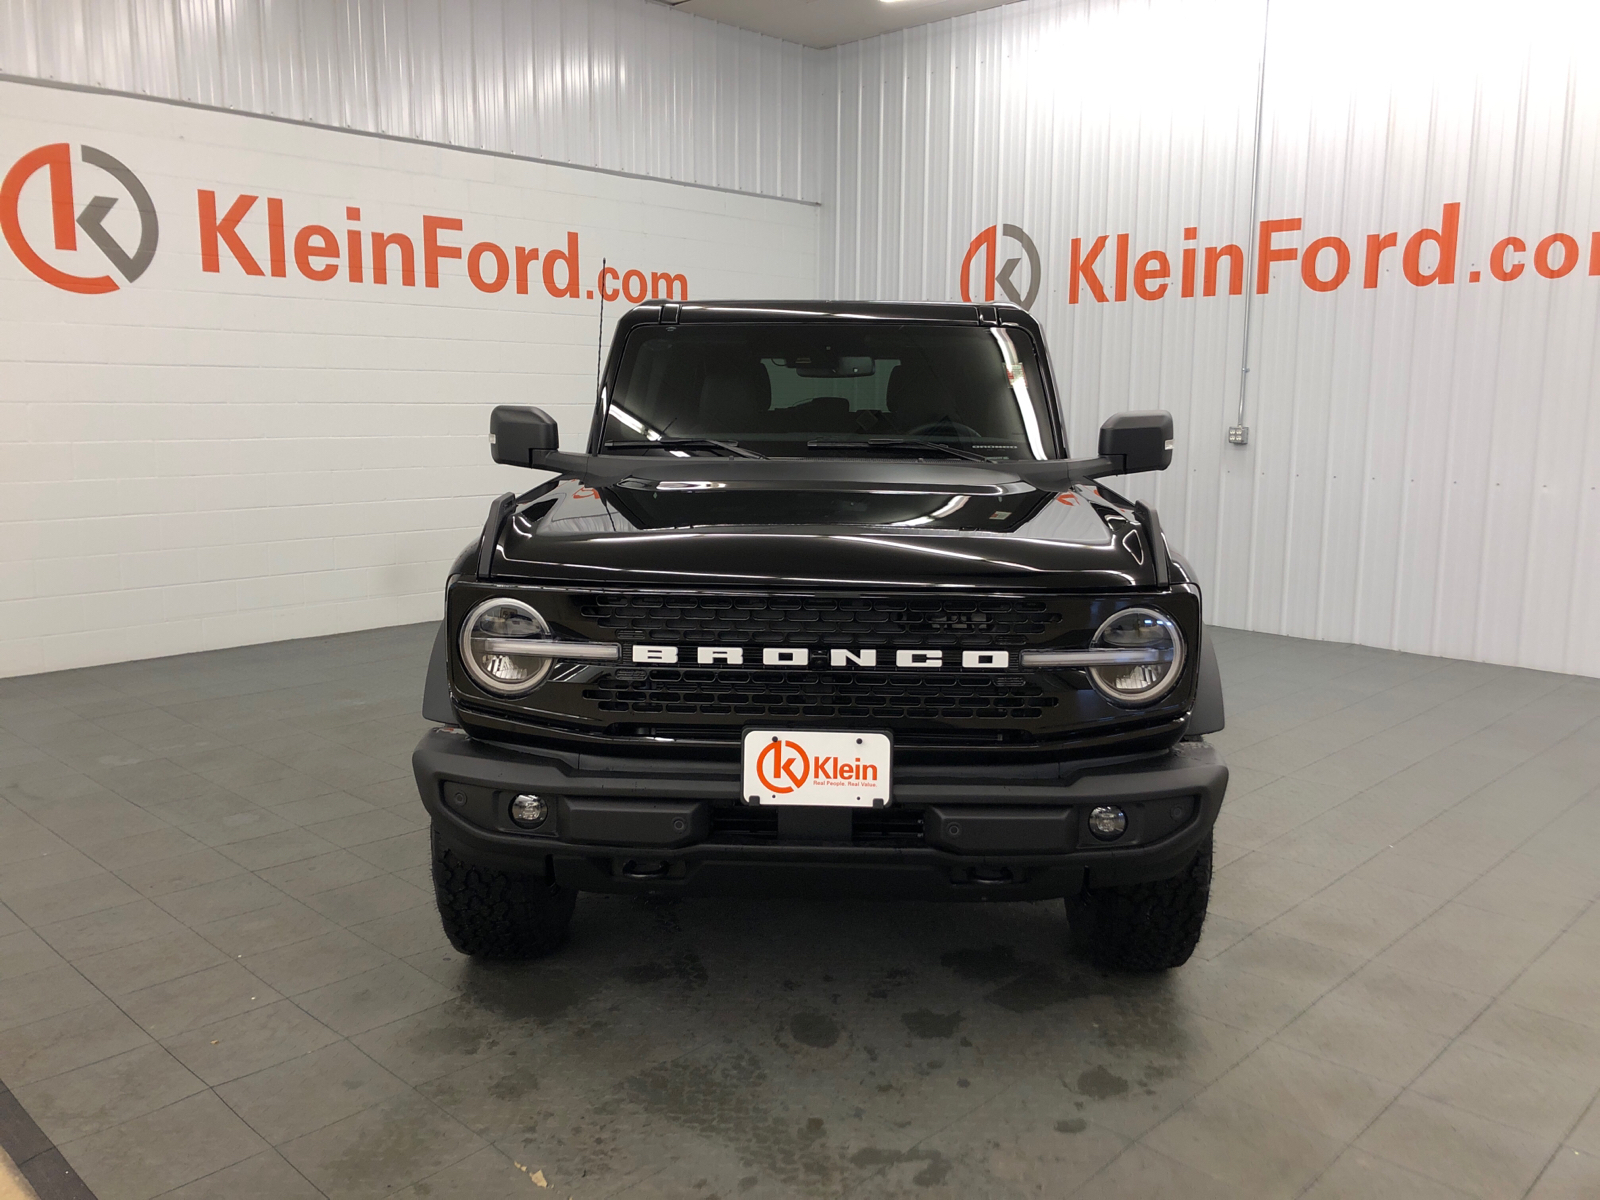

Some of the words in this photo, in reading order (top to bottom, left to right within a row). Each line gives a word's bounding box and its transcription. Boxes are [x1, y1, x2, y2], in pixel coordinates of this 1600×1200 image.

[196, 188, 689, 304] KleinFord.com
[1067, 201, 1600, 305] KleinFord.co
[632, 644, 1009, 668] BRONCO
[813, 755, 878, 781] Klein
